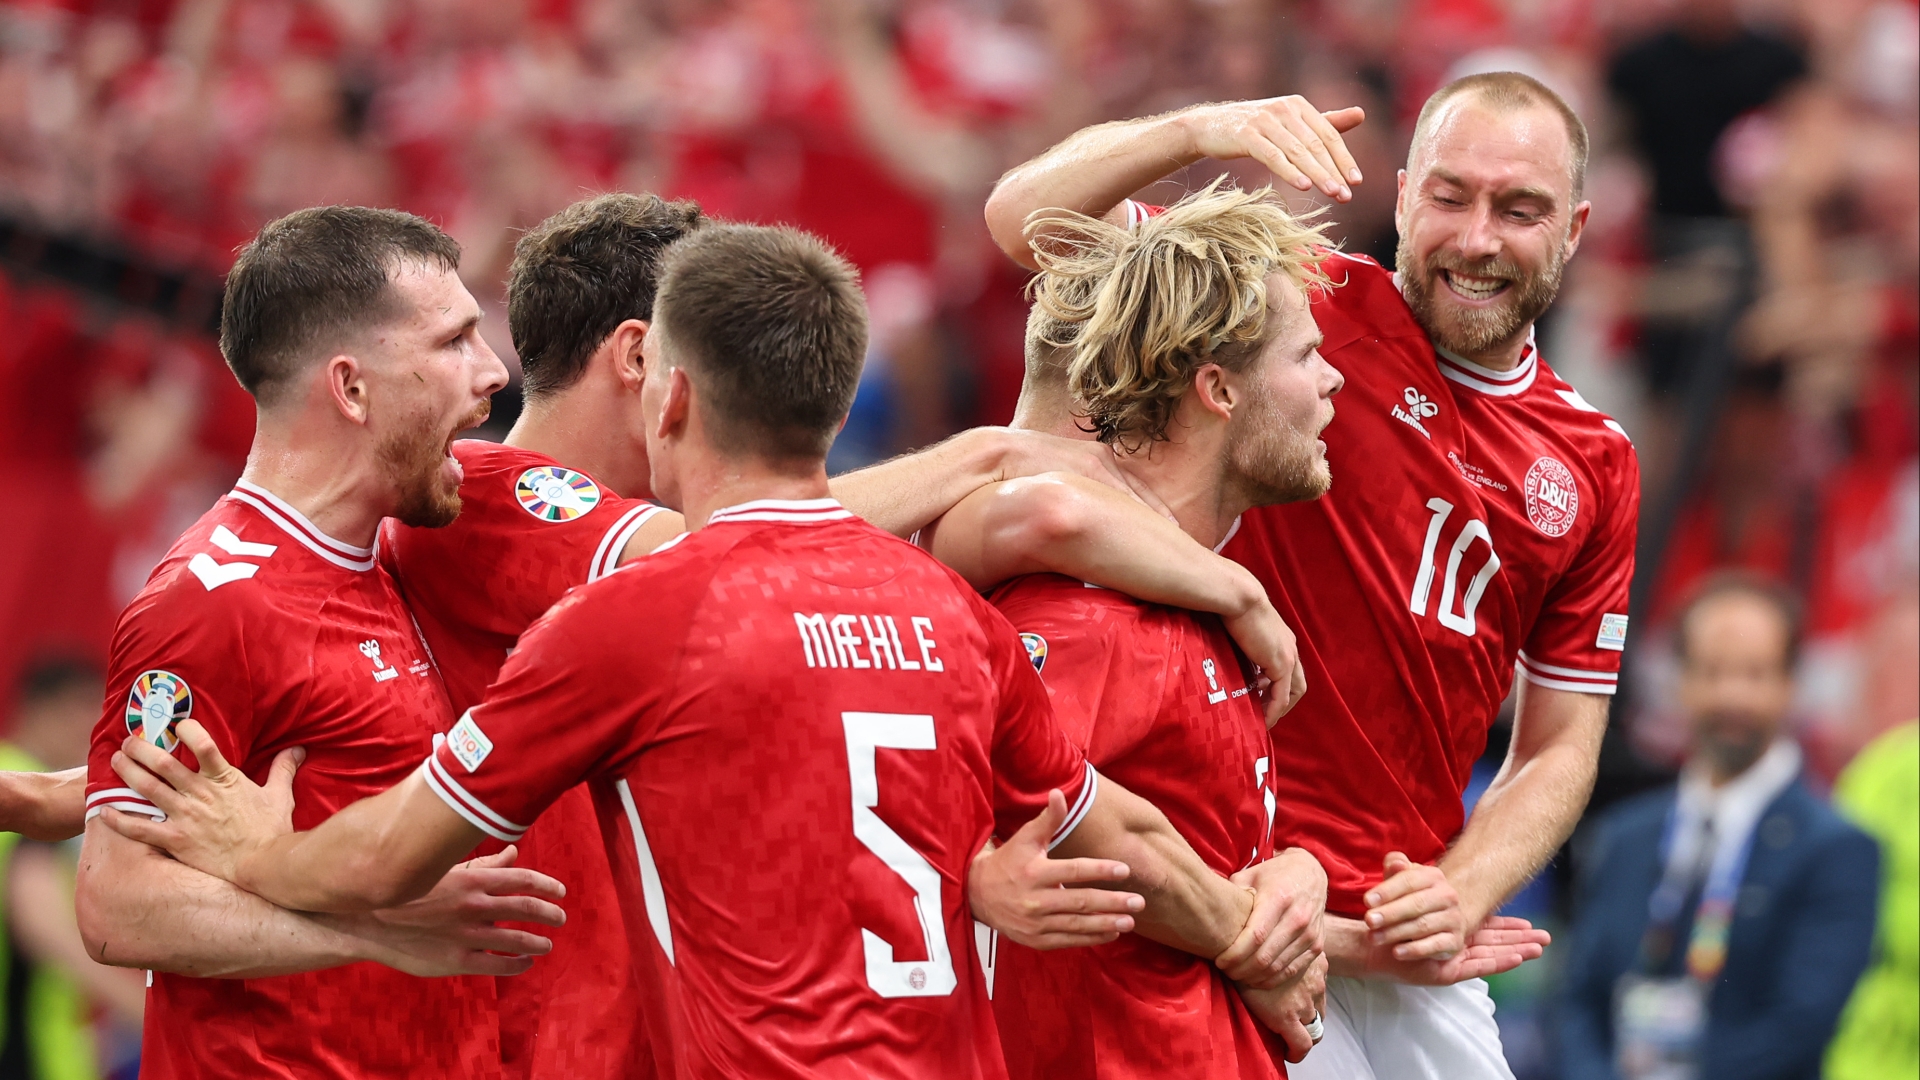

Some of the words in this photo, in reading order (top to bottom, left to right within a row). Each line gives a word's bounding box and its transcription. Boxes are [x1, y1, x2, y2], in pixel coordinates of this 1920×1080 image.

[1476, 475, 1508, 492] ENGLAND
[1527, 468, 1541, 516] DANSK
[1537, 478, 1569, 512] DBU
[1535, 517, 1559, 535] 1889
[1410, 497, 1501, 637] 10
[793, 612, 944, 672] MÆHLE
[841, 712, 958, 998] 5
